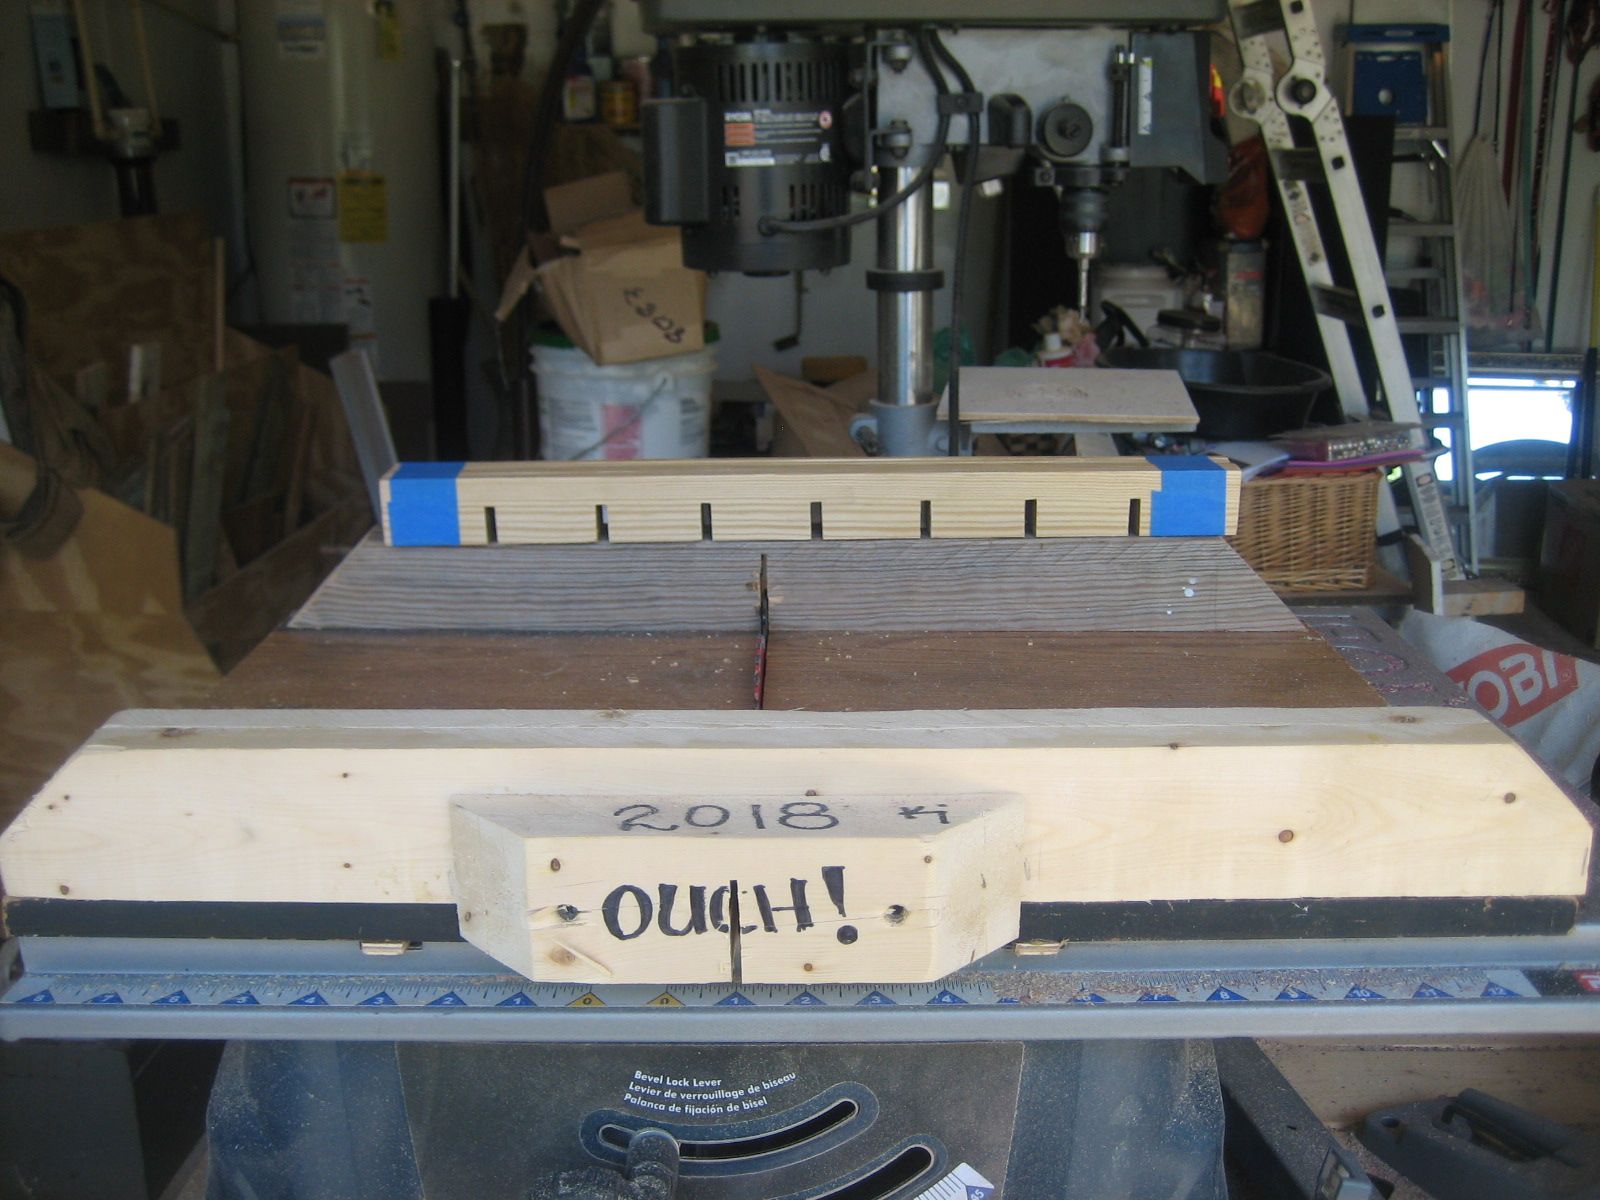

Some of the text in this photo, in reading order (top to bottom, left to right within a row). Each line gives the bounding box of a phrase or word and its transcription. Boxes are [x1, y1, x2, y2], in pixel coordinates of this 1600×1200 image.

[1458, 650, 1560, 720] OBI
[613, 801, 840, 832] 2018
[602, 866, 859, 946] OUCH!
[373, 997, 384, 1005] 3
[444, 997, 454, 1005] 2
[582, 998, 593, 1006] 0
[730, 997, 740, 1005] 1
[800, 997, 812, 1005] 2
[871, 996, 882, 1004] 3
[941, 994, 952, 1003] 4
[1220, 991, 1231, 1000] 8
[1352, 988, 1371, 998] 10
[1423, 988, 1438, 997] 11
[1488, 986, 1508, 996] 12
[628, 1072, 797, 1101] Levier de verrouillage de biseau
[634, 1070, 722, 1087] Bevel Lock Lever
[624, 1093, 768, 1116] Palanca de fijación de bisel
